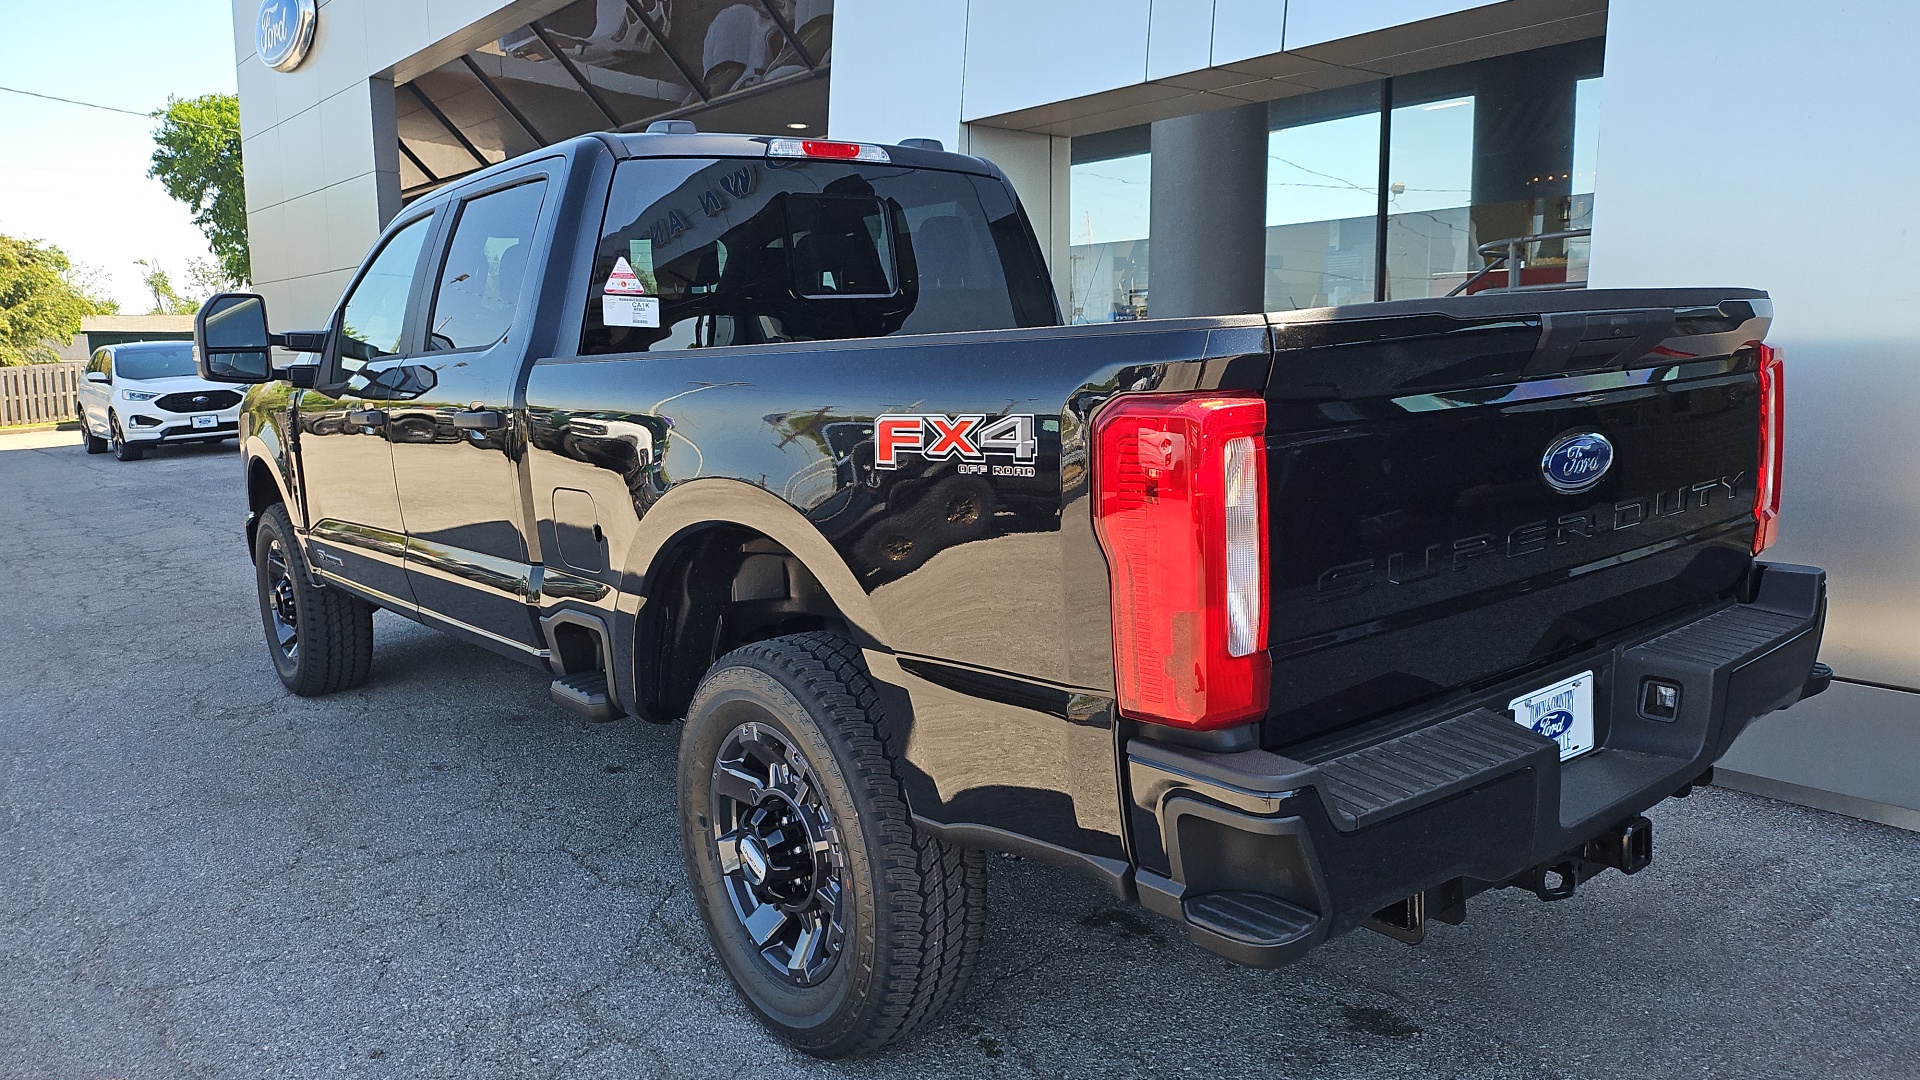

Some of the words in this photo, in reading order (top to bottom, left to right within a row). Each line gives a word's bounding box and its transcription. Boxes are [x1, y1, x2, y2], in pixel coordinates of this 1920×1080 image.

[261, 2, 287, 54] Ford
[631, 301, 650, 309] CA1K
[874, 413, 1038, 470] FX4
[958, 463, 988, 475] OFF
[992, 465, 1036, 478] ROAD
[1563, 444, 1601, 476] Ford
[1317, 511, 1597, 603] SUPER
[1613, 470, 1746, 532] DUTY
[1537, 713, 1566, 737] Ford
